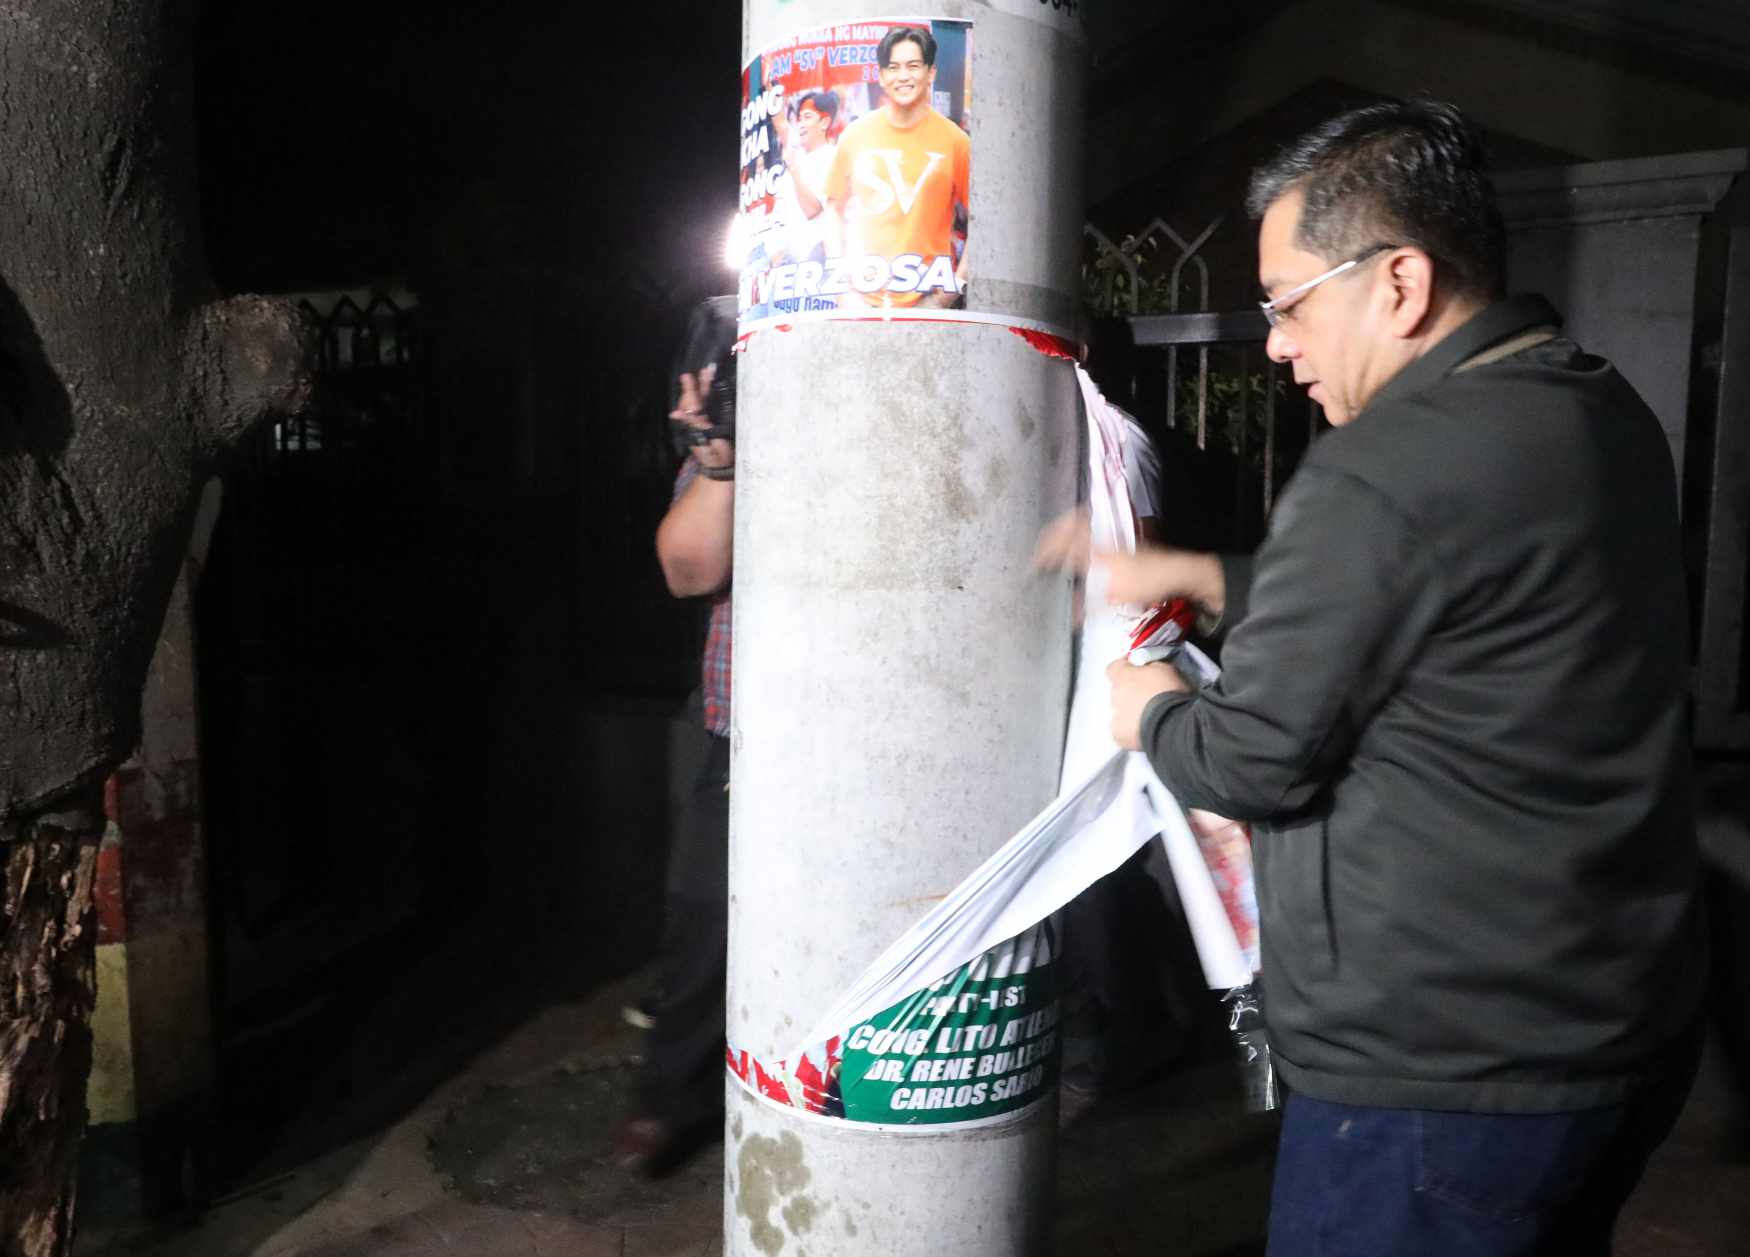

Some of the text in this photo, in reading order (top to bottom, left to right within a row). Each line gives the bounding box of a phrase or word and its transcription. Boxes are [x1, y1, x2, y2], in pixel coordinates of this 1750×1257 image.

[848, 148, 946, 216] SV
[757, 253, 959, 304] VERZOSA
[910, 1056, 978, 1083] RENE
[890, 1081, 990, 1111] CARLOS
